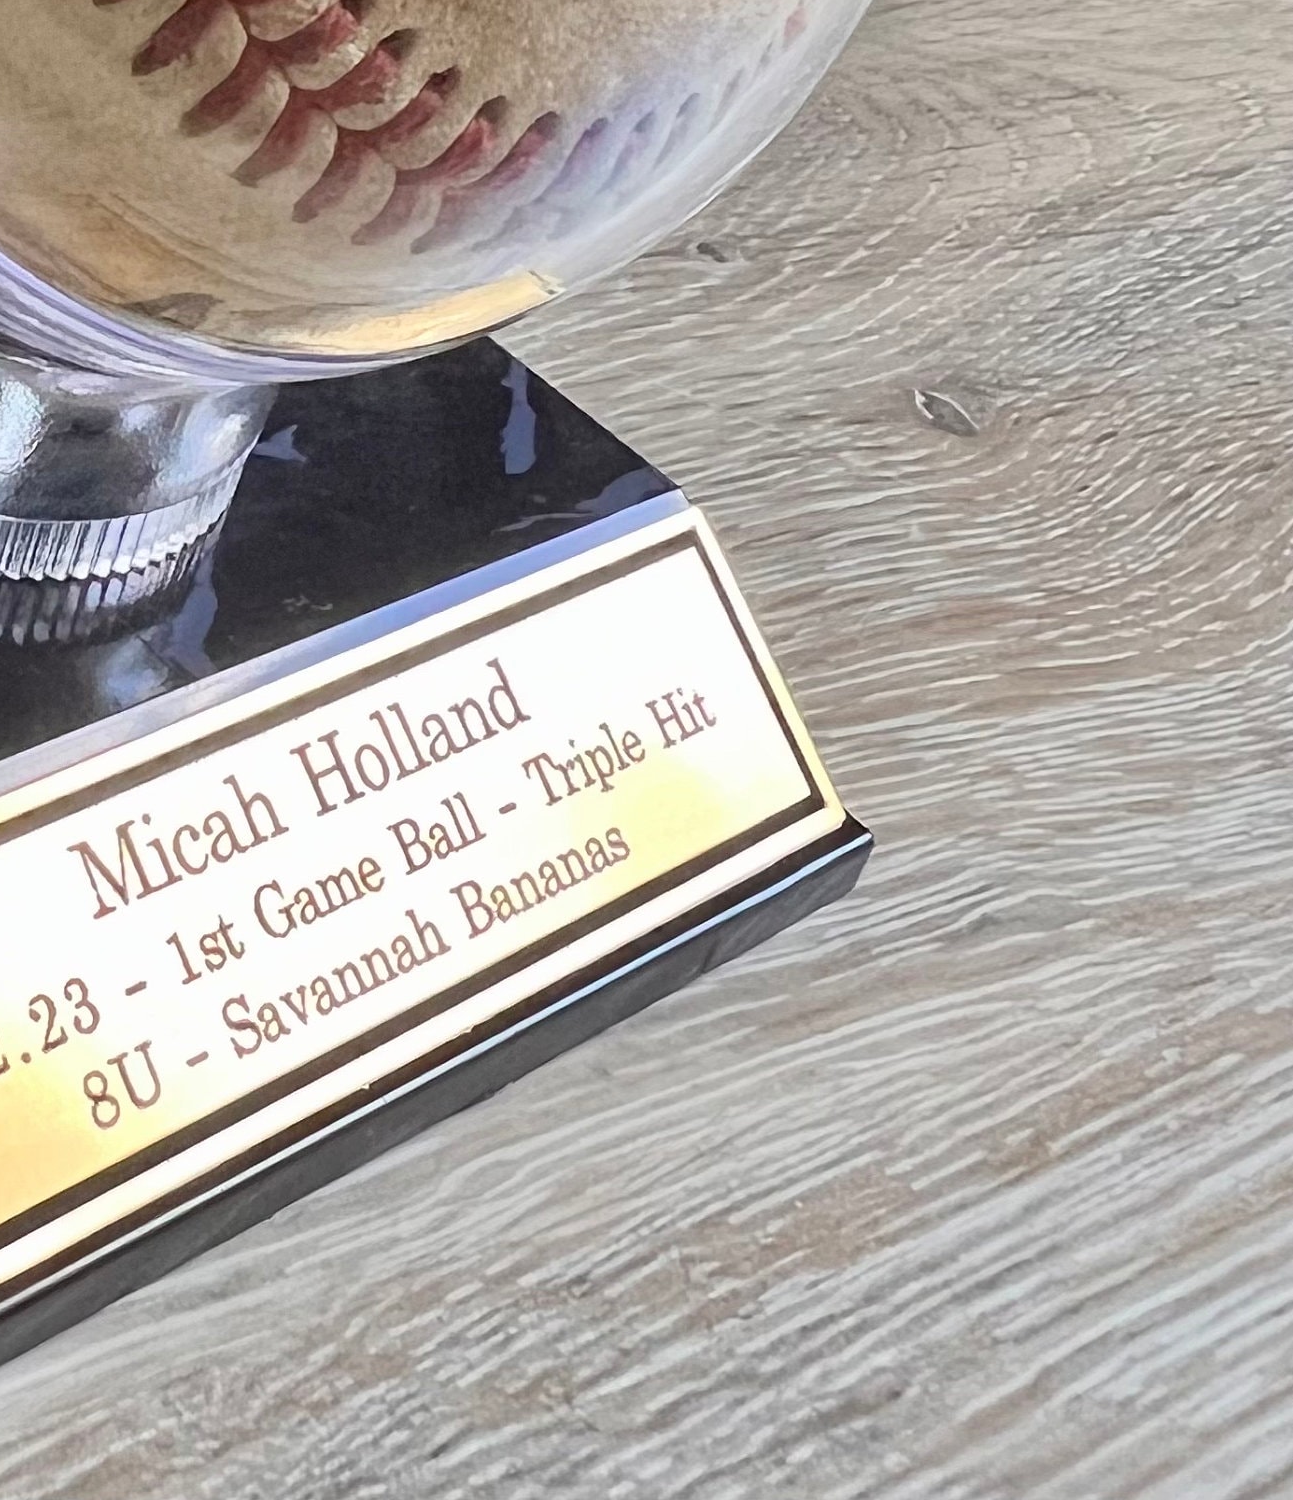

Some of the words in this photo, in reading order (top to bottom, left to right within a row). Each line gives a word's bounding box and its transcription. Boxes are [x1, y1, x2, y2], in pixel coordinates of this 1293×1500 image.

[67, 775, 289, 919] Micah
[290, 658, 532, 816] Holland
[125, 981, 148, 997] -
[166, 915, 246, 985] 1st
[254, 856, 386, 939] Game
[386, 792, 487, 875] Ball
[499, 803, 517, 814] -
[522, 723, 646, 806] Triple
[645, 688, 717, 749] Hit
[83, 1041, 161, 1129] 8U
[186, 1052, 209, 1067] -
[222, 909, 452, 1059] Savannah
[450, 827, 631, 939] Bananas
